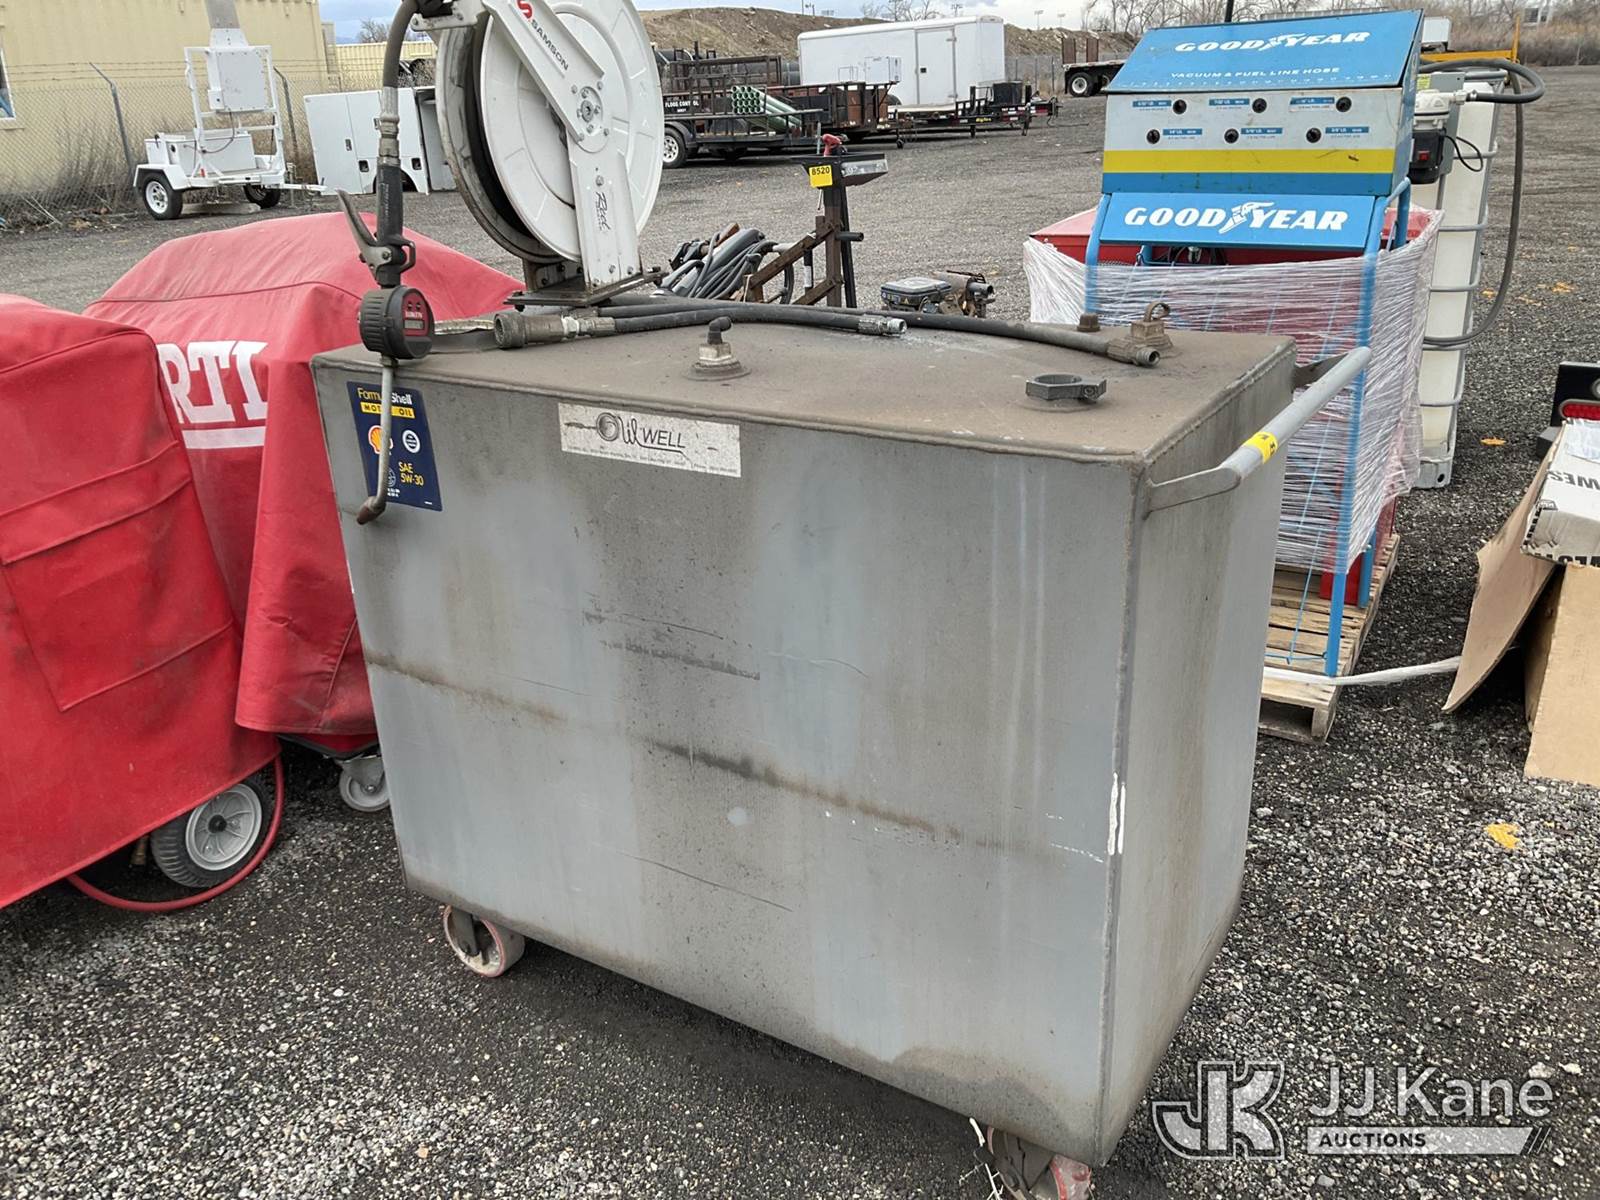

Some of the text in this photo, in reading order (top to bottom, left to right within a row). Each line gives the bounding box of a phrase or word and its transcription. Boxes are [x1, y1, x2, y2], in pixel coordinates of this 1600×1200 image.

[531, 19, 569, 71] SAMSON
[811, 166, 830, 176] 8520
[1124, 206, 1348, 231] GOODYEAR
[391, 392, 413, 405] Shell
[363, 403, 413, 417] MOT OIL
[398, 461, 414, 474] SAE
[400, 472, 424, 486] 5W-30
